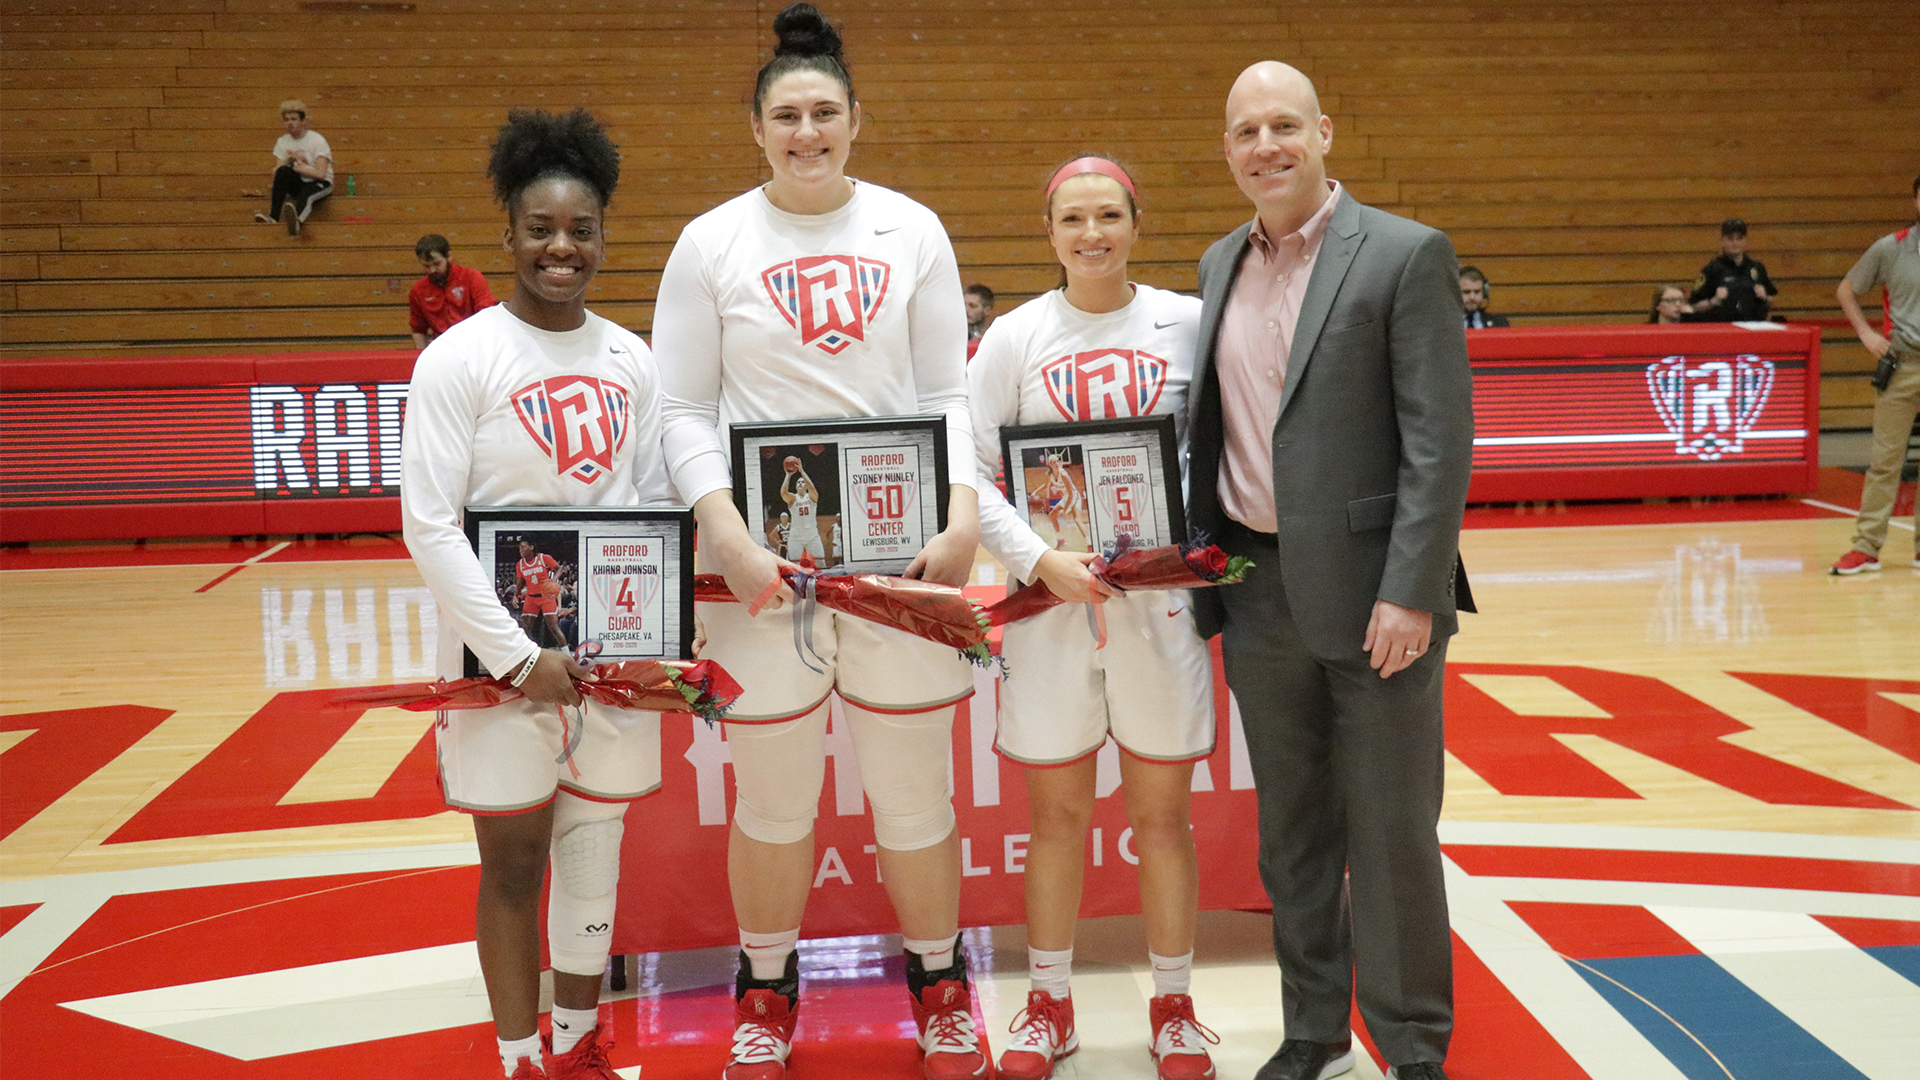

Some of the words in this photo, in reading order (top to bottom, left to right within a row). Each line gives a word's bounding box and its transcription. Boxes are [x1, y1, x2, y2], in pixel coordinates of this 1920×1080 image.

[862, 454, 904, 466] RADFORD
[1102, 455, 1136, 468] RADFORD
[853, 473, 882, 484] SYDNEY
[885, 472, 915, 482] NUNLEY
[1098, 476, 1111, 486] JEN
[1112, 474, 1144, 484] FALCONER
[867, 485, 903, 520] 50
[1116, 487, 1132, 520] 5
[799, 506, 809, 516] 50
[868, 522, 904, 536] CENTER
[862, 538, 900, 547] LEWISBURG,
[1147, 538, 1155, 547] PA
[603, 545, 648, 556] RADFORD
[593, 565, 620, 574] KHIANA
[623, 565, 658, 574] JOHNSON
[616, 578, 635, 613] 4
[608, 616, 642, 630] GUARD
[598, 632, 642, 640] CHESAPEAKE,
[644, 632, 652, 640] VA
